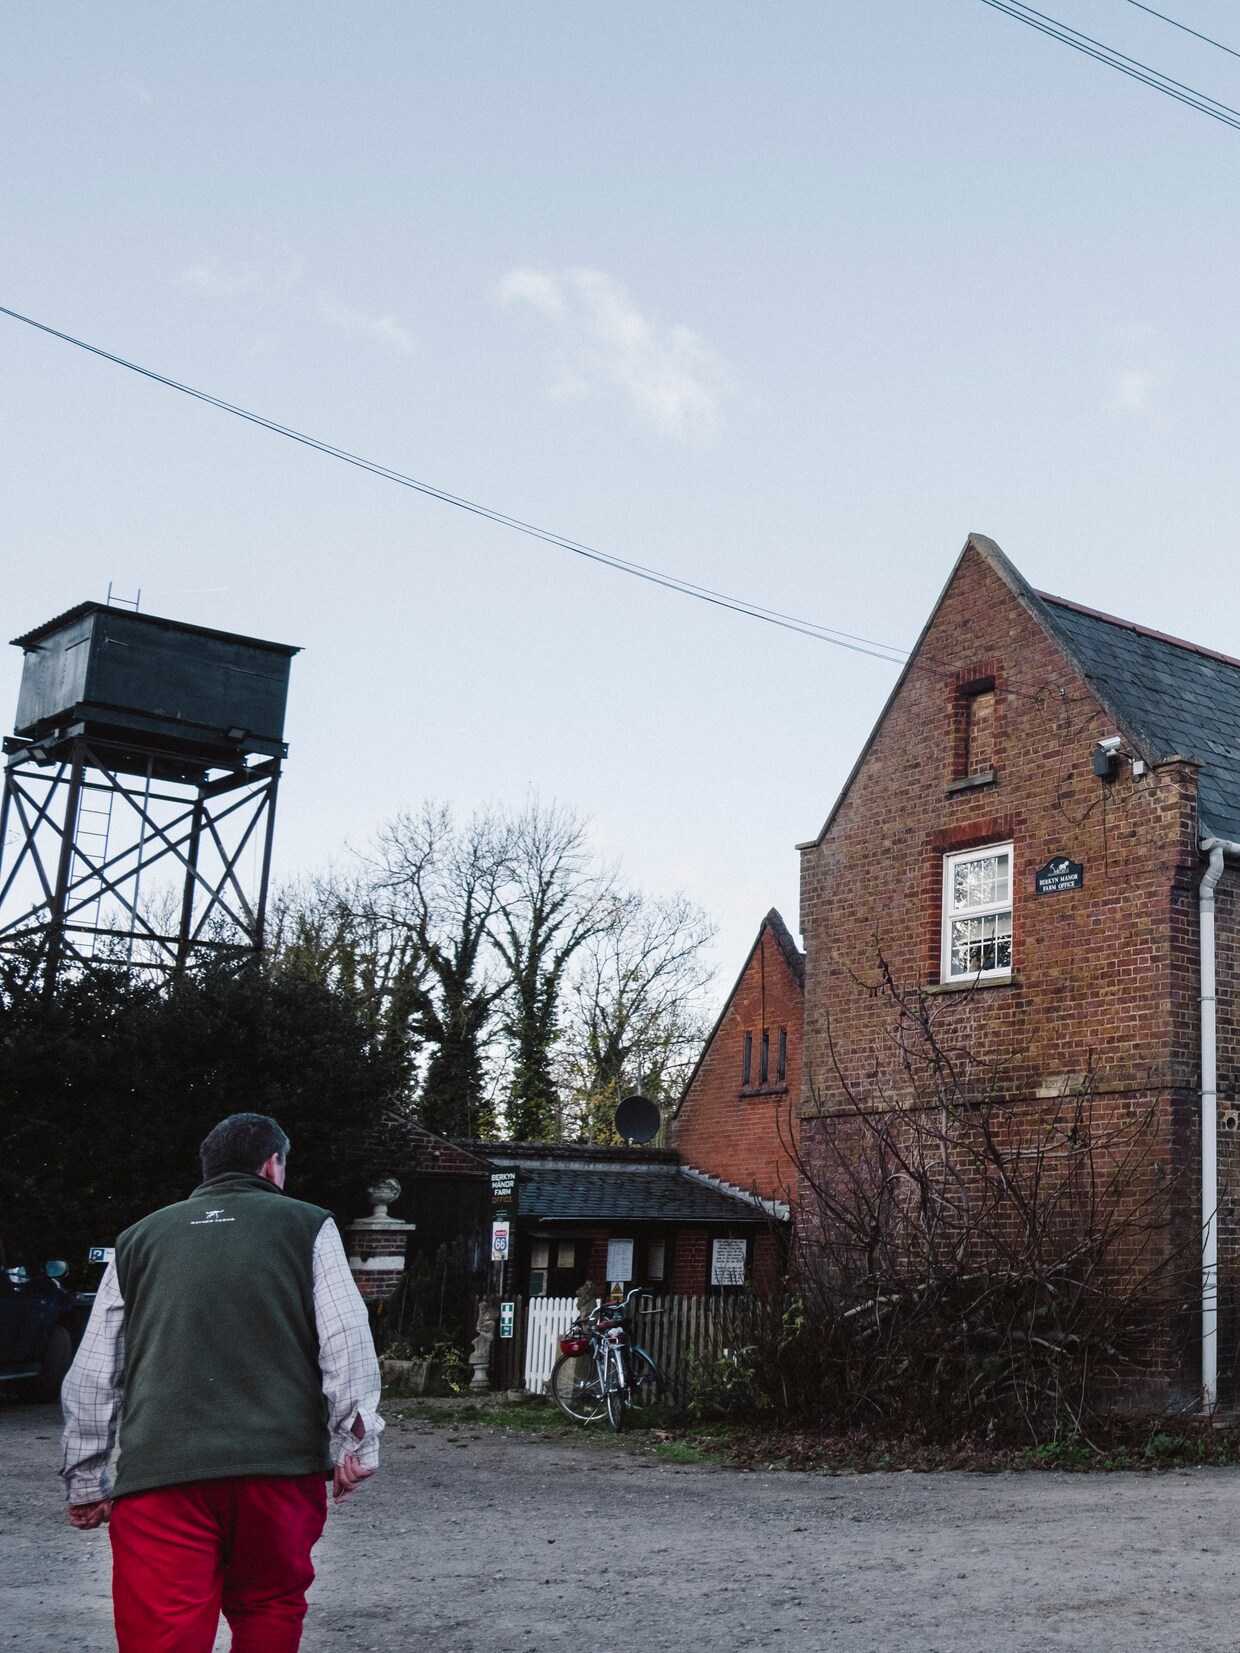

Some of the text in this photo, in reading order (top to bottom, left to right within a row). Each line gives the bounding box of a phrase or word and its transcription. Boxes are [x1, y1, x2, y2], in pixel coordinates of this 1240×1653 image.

[1040, 873, 1078, 886] BERKYN MANOR
[1042, 880, 1075, 892] FARM OFFICE
[491, 1173, 516, 1181] BERKYN
[491, 1181, 514, 1189] MANOR
[494, 1188, 511, 1196] FARM
[491, 1196, 513, 1204] OFFICE
[495, 1238, 506, 1250] 66
